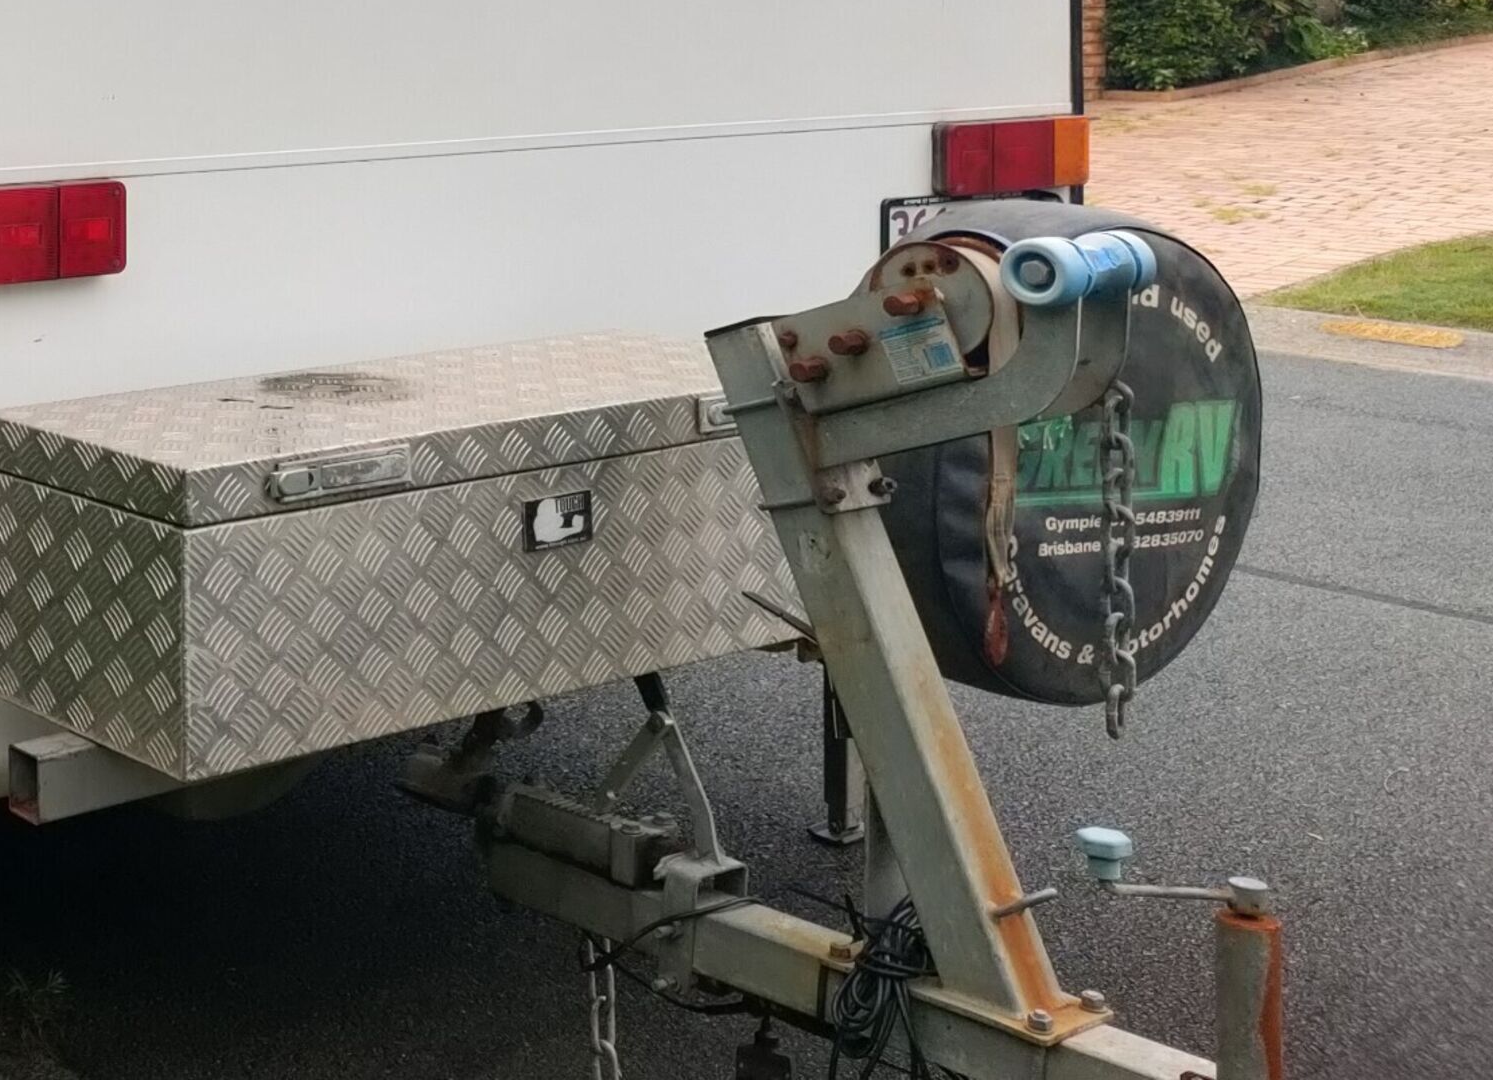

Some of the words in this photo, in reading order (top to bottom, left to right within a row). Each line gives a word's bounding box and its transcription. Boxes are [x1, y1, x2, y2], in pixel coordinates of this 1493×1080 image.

[1170, 295, 1223, 363] used
[1135, 508, 1201, 526] 54839111
[1038, 537, 1102, 557] Brisbane
[1133, 529, 1204, 549] 32835070
[1076, 643, 1096, 664] &
[1120, 515, 1227, 658] otorhomes
